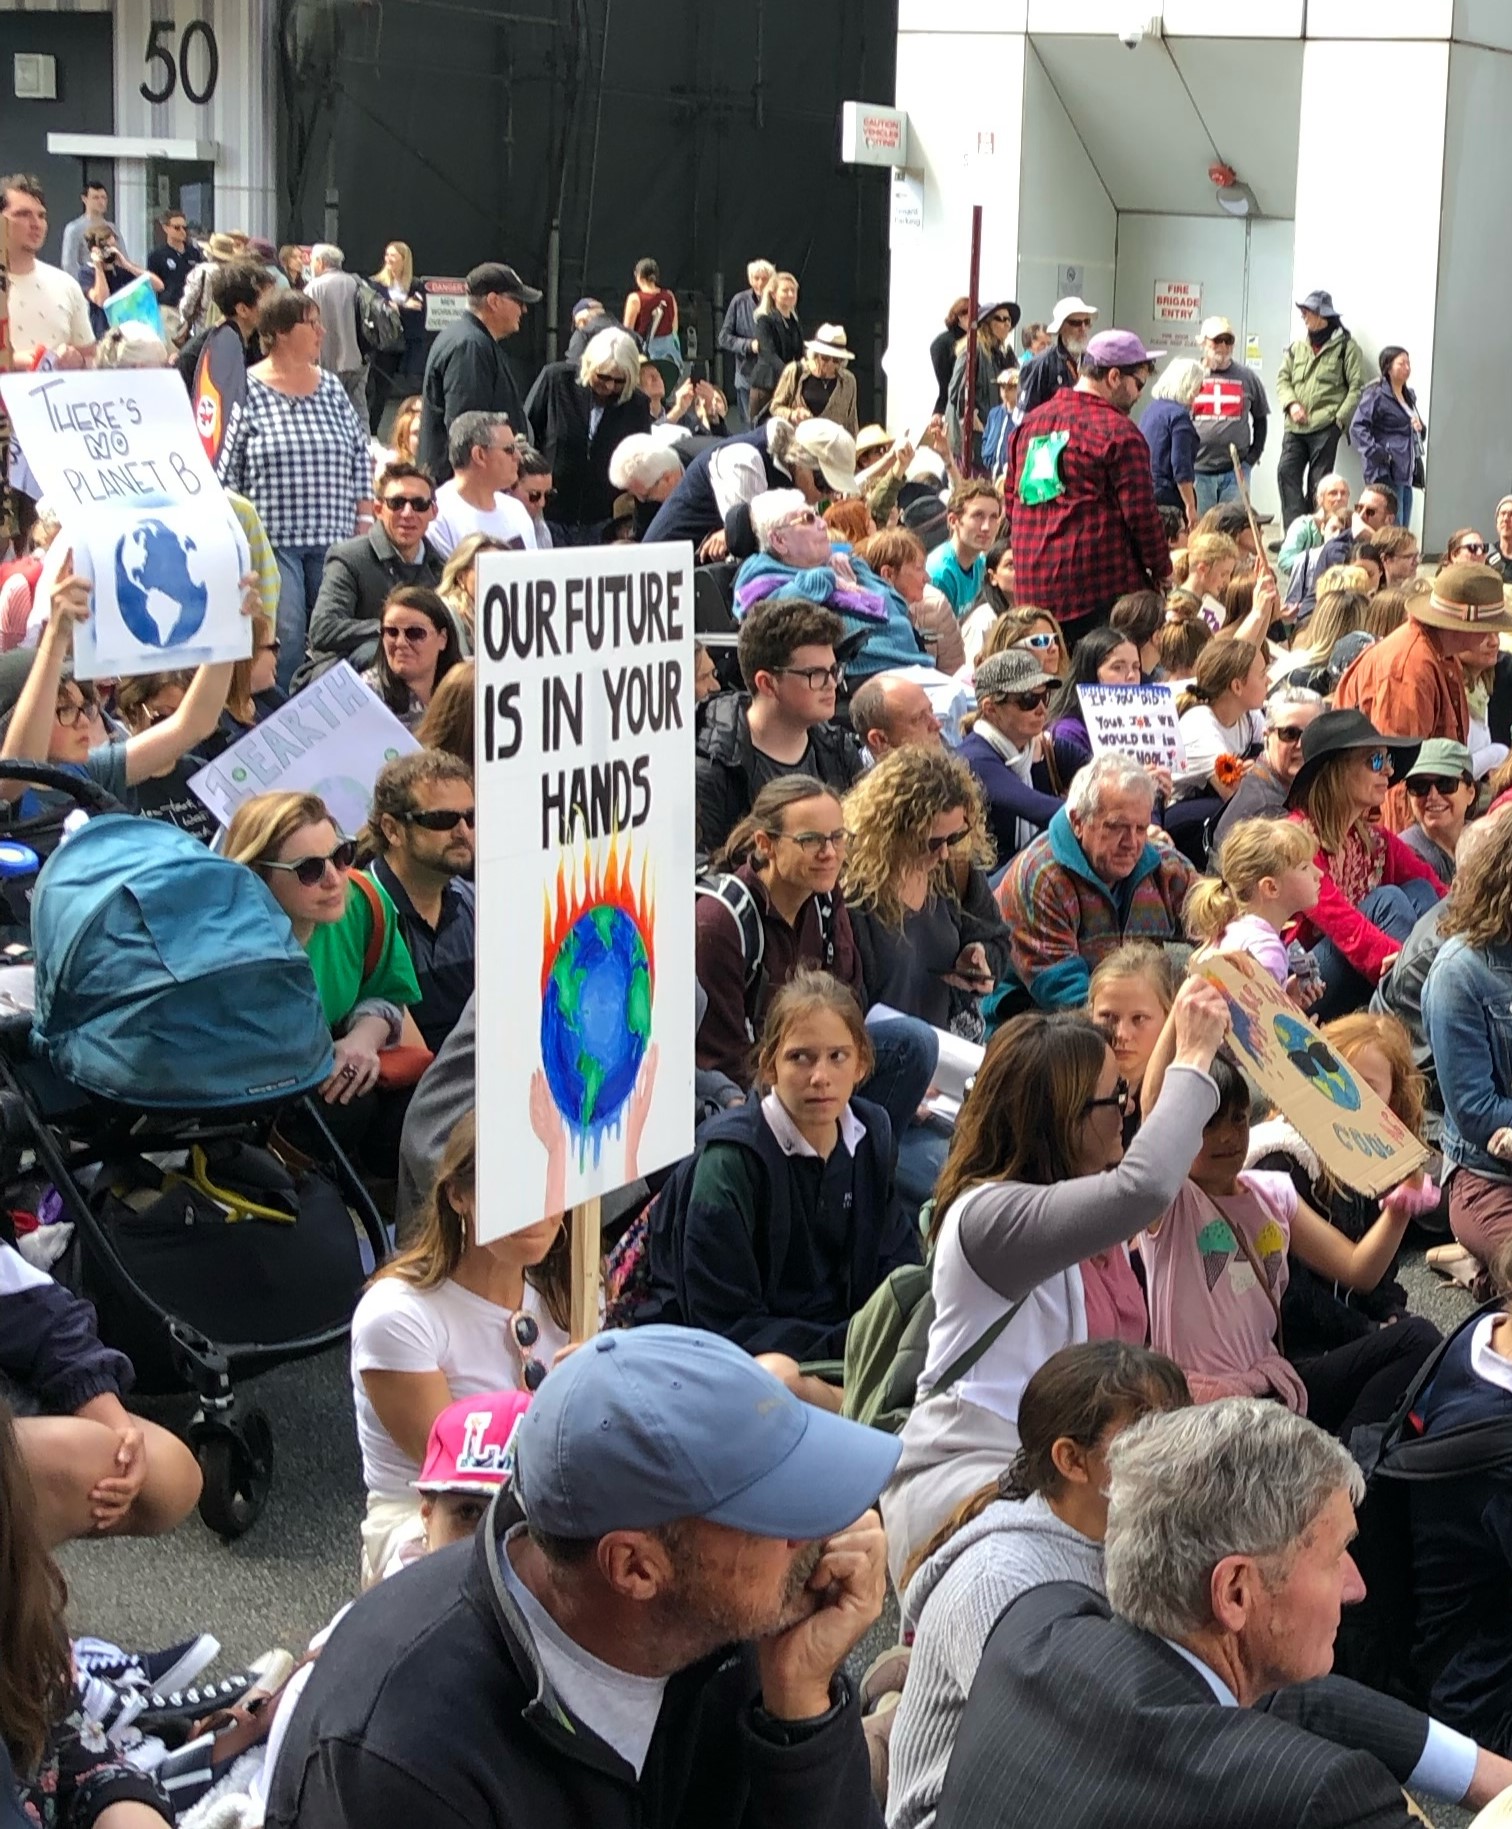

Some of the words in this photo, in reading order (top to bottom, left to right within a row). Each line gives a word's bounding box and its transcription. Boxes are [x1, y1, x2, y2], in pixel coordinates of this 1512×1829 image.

[139, 20, 219, 104] 50
[863, 117, 898, 129] CAUTION
[431, 282, 464, 293] DANGER
[1156, 295, 1200, 308] BRIGADE
[1167, 283, 1190, 295] FIRE
[1161, 308, 1194, 320] ENTRY
[28, 378, 142, 433] THERE'S
[83, 430, 130, 460] NO
[63, 461, 167, 505] PLANET
[169, 451, 201, 495] B
[483, 579, 562, 662] OUR
[565, 570, 683, 654] FUTURE
[234, 665, 370, 787] EARTH
[485, 682, 523, 762] IS
[542, 672, 583, 753] IN
[602, 660, 683, 741] YOUR
[1095, 715, 1125, 730] YOUR
[1098, 733, 1138, 746] WOULD
[542, 754, 651, 850] HANDS
